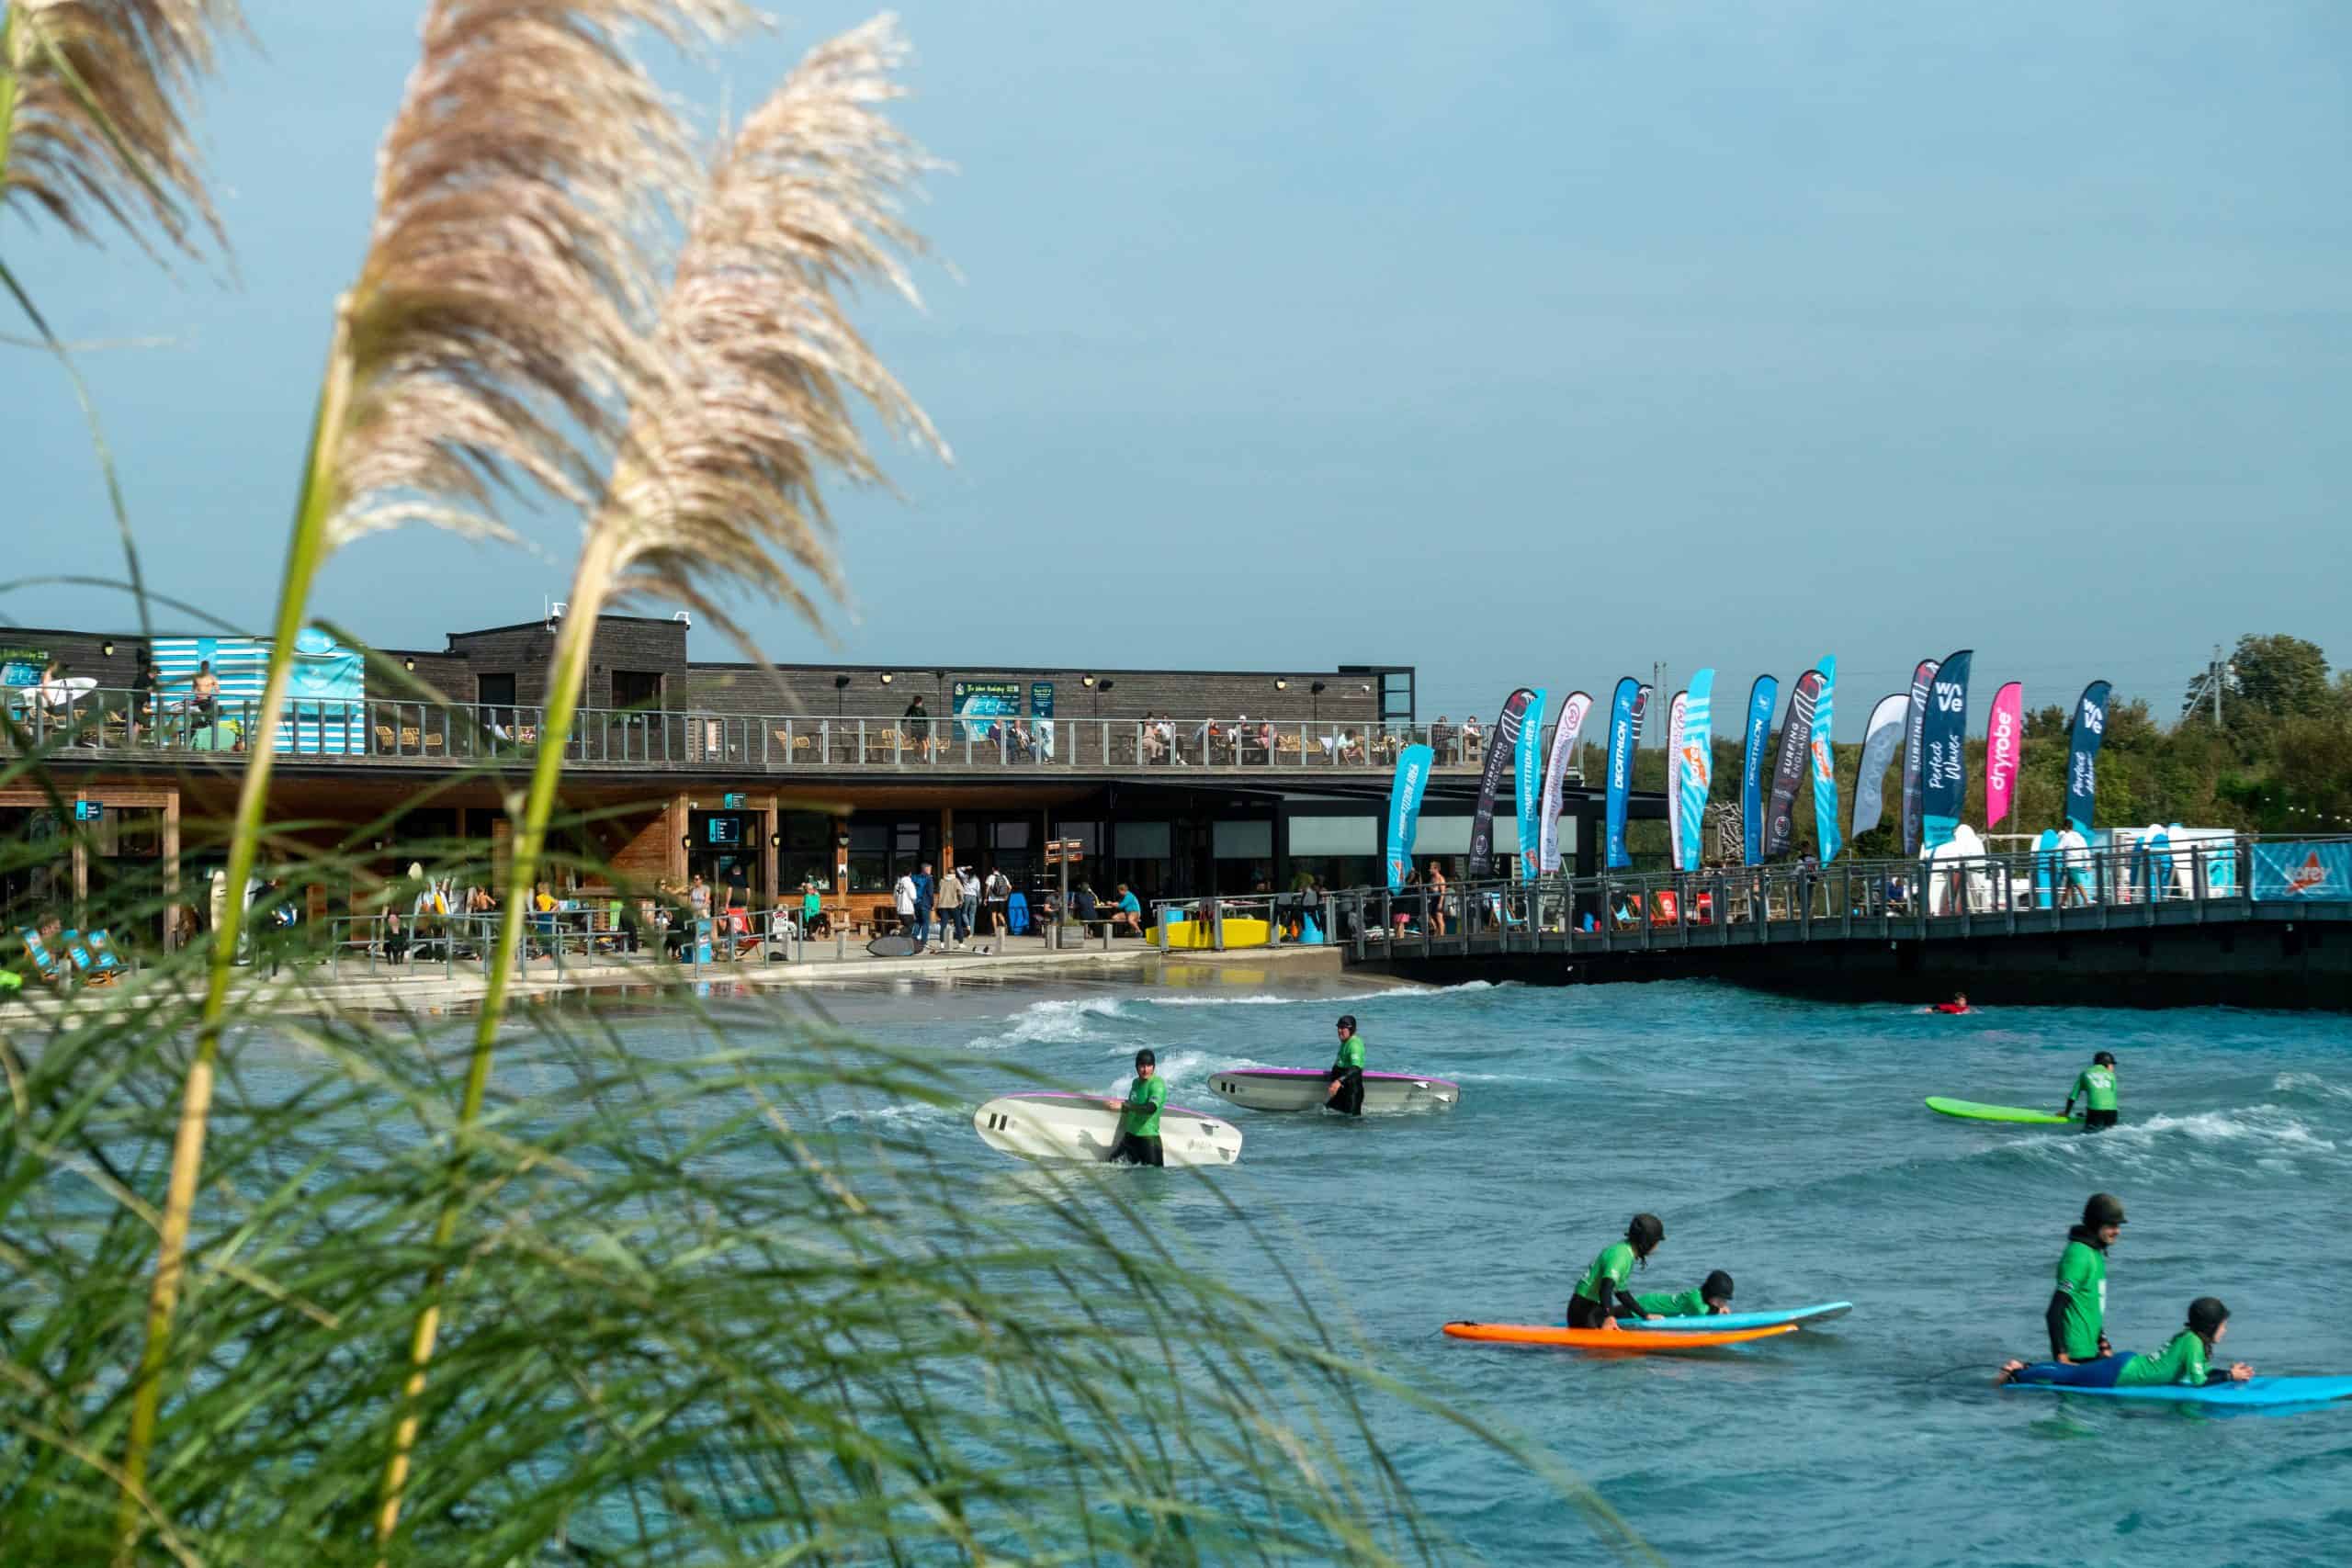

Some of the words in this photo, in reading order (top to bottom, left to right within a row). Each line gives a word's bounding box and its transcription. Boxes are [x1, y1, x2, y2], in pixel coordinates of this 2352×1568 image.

[1524, 719, 1536, 750] AREA
[1614, 720, 1626, 789] DECATHLON
[1749, 718, 1763, 787] DECATHLON
[1783, 722, 1799, 774] SURFING
[1792, 727, 1808, 779] ENGLAND
[1911, 716, 1923, 771] SURFING
[1945, 734, 1961, 781] Waves
[1990, 711, 2013, 791] dryrobe
[1485, 741, 1503, 795] SURFING
[1489, 744, 1509, 796] ENGLAND
[1523, 752, 1534, 821] COMPETITION
[1928, 740, 1945, 789] Perfect
